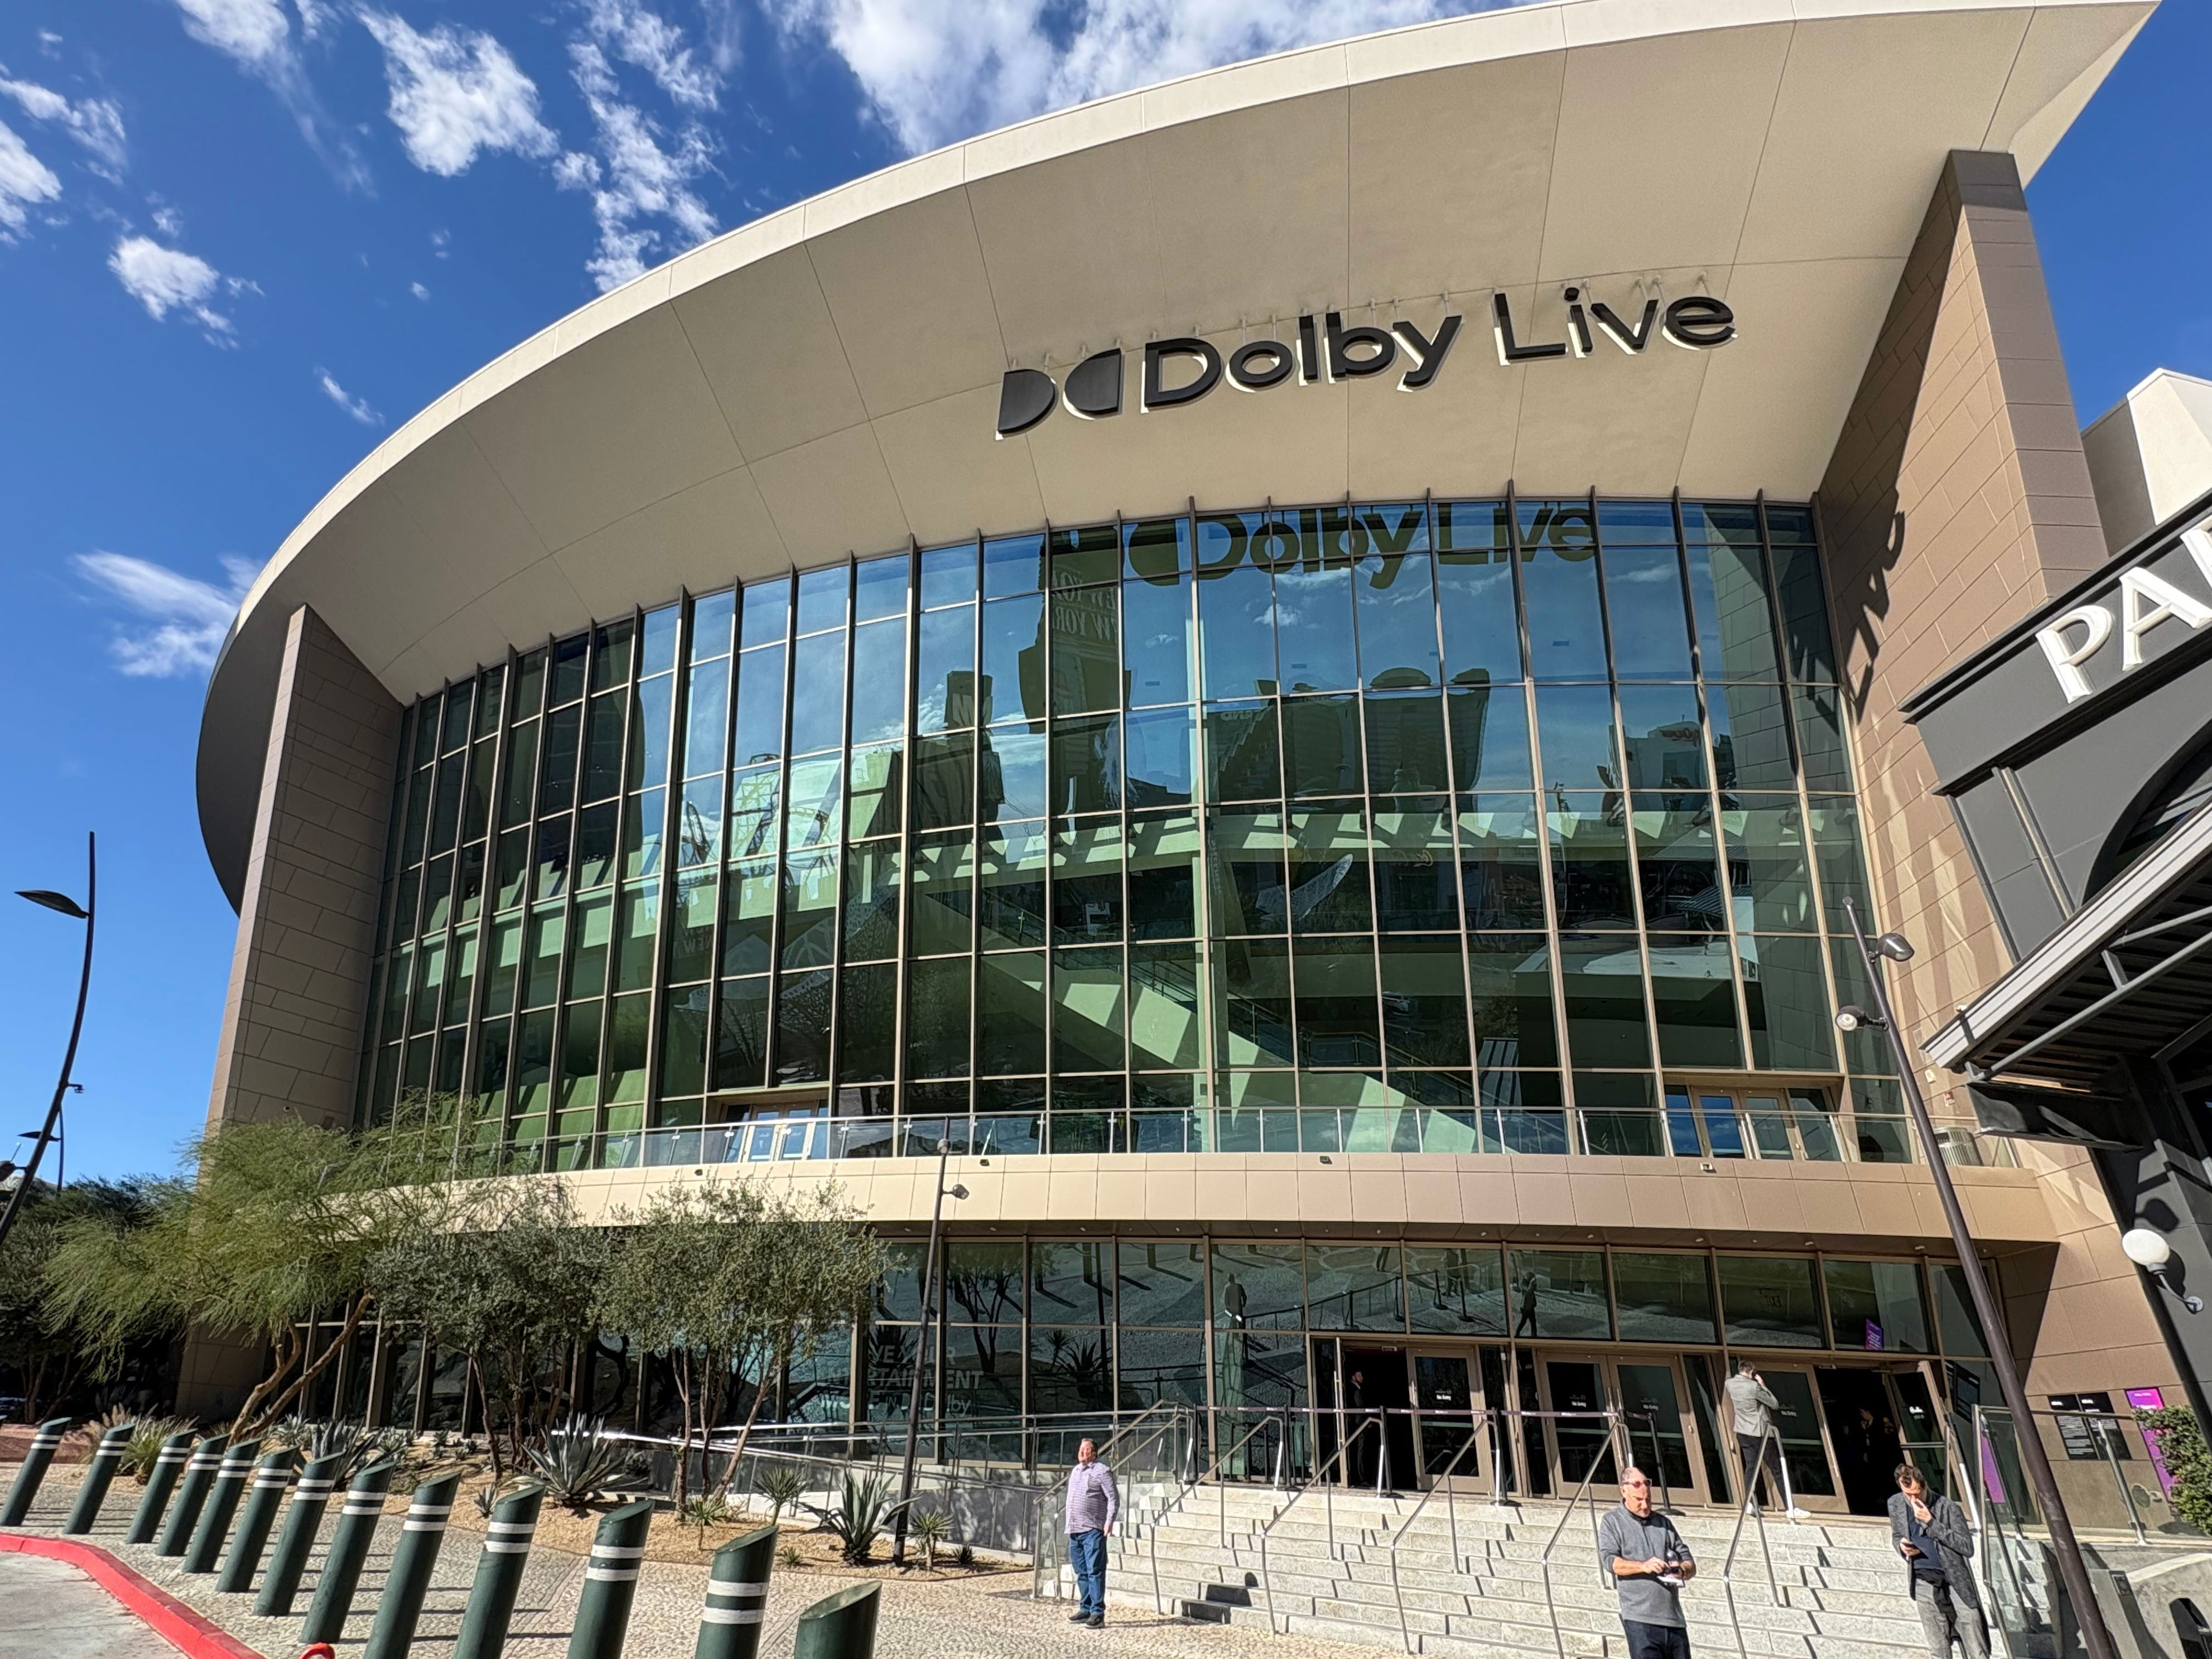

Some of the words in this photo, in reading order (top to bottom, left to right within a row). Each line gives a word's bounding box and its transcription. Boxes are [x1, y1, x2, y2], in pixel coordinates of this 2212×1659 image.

[1142, 311, 1463, 413] Dolby
[1495, 286, 1737, 366] Live
[1197, 508, 1424, 590] Dolby
[1438, 502, 1596, 565] Live
[923, 1392, 972, 1417] Dlby
